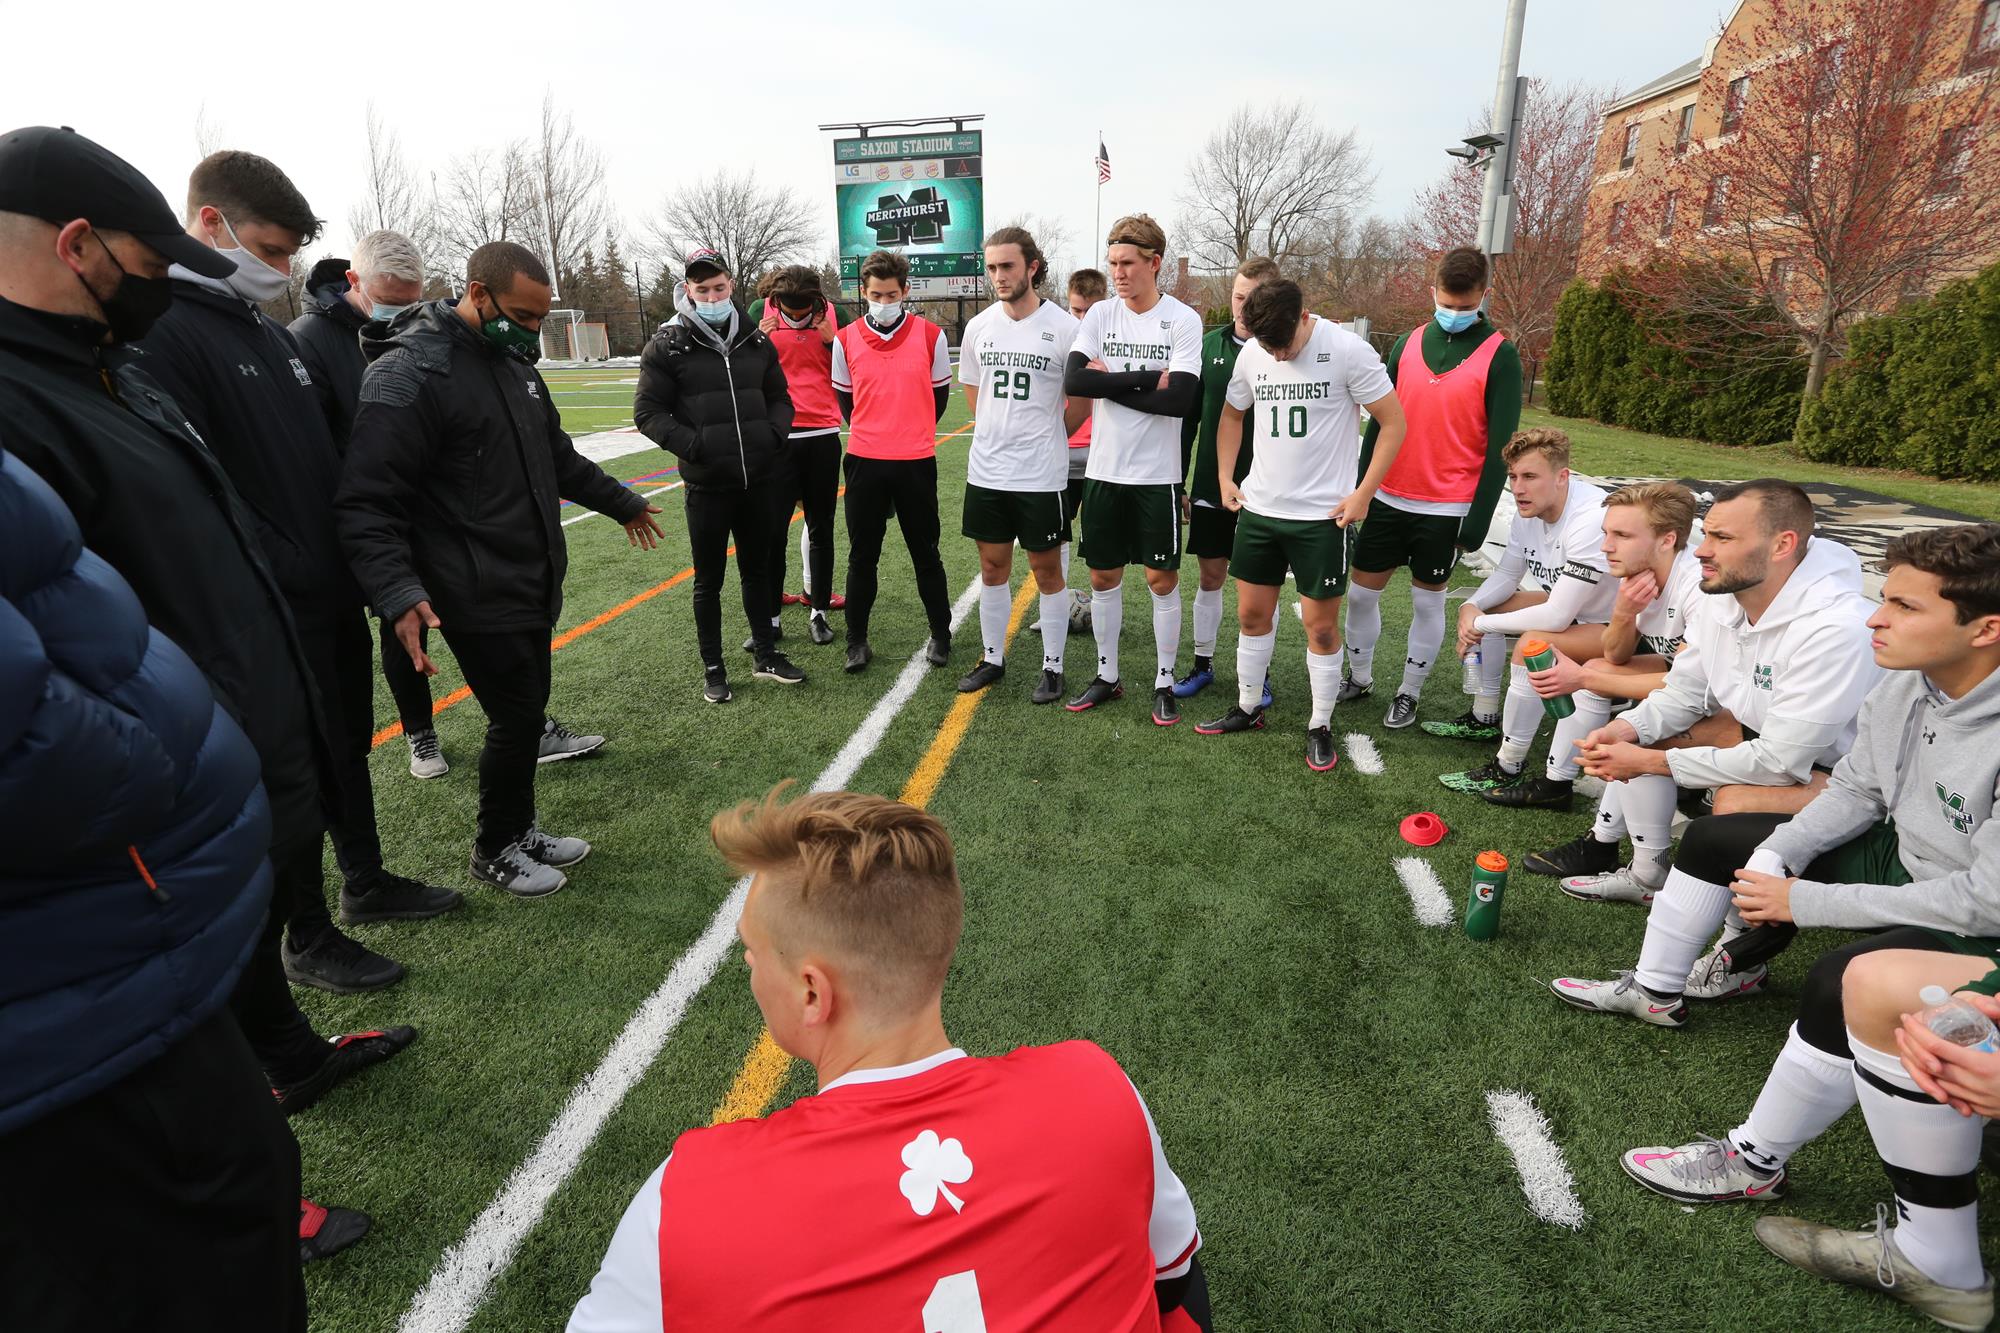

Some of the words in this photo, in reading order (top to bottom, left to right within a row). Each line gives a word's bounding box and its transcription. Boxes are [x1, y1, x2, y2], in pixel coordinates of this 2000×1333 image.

[860, 142, 898, 156] SAXON
[902, 138, 953, 153] STADIUM
[845, 165, 859, 176] LG
[867, 201, 945, 223] MERCYHURST
[843, 265, 849, 273] 2
[1102, 342, 1171, 360] MERCYHURST
[980, 352, 1051, 371] MERCYHURST
[993, 370, 1031, 401] 29
[1255, 381, 1331, 400] MERCYHURST
[1270, 405, 1308, 438] 10
